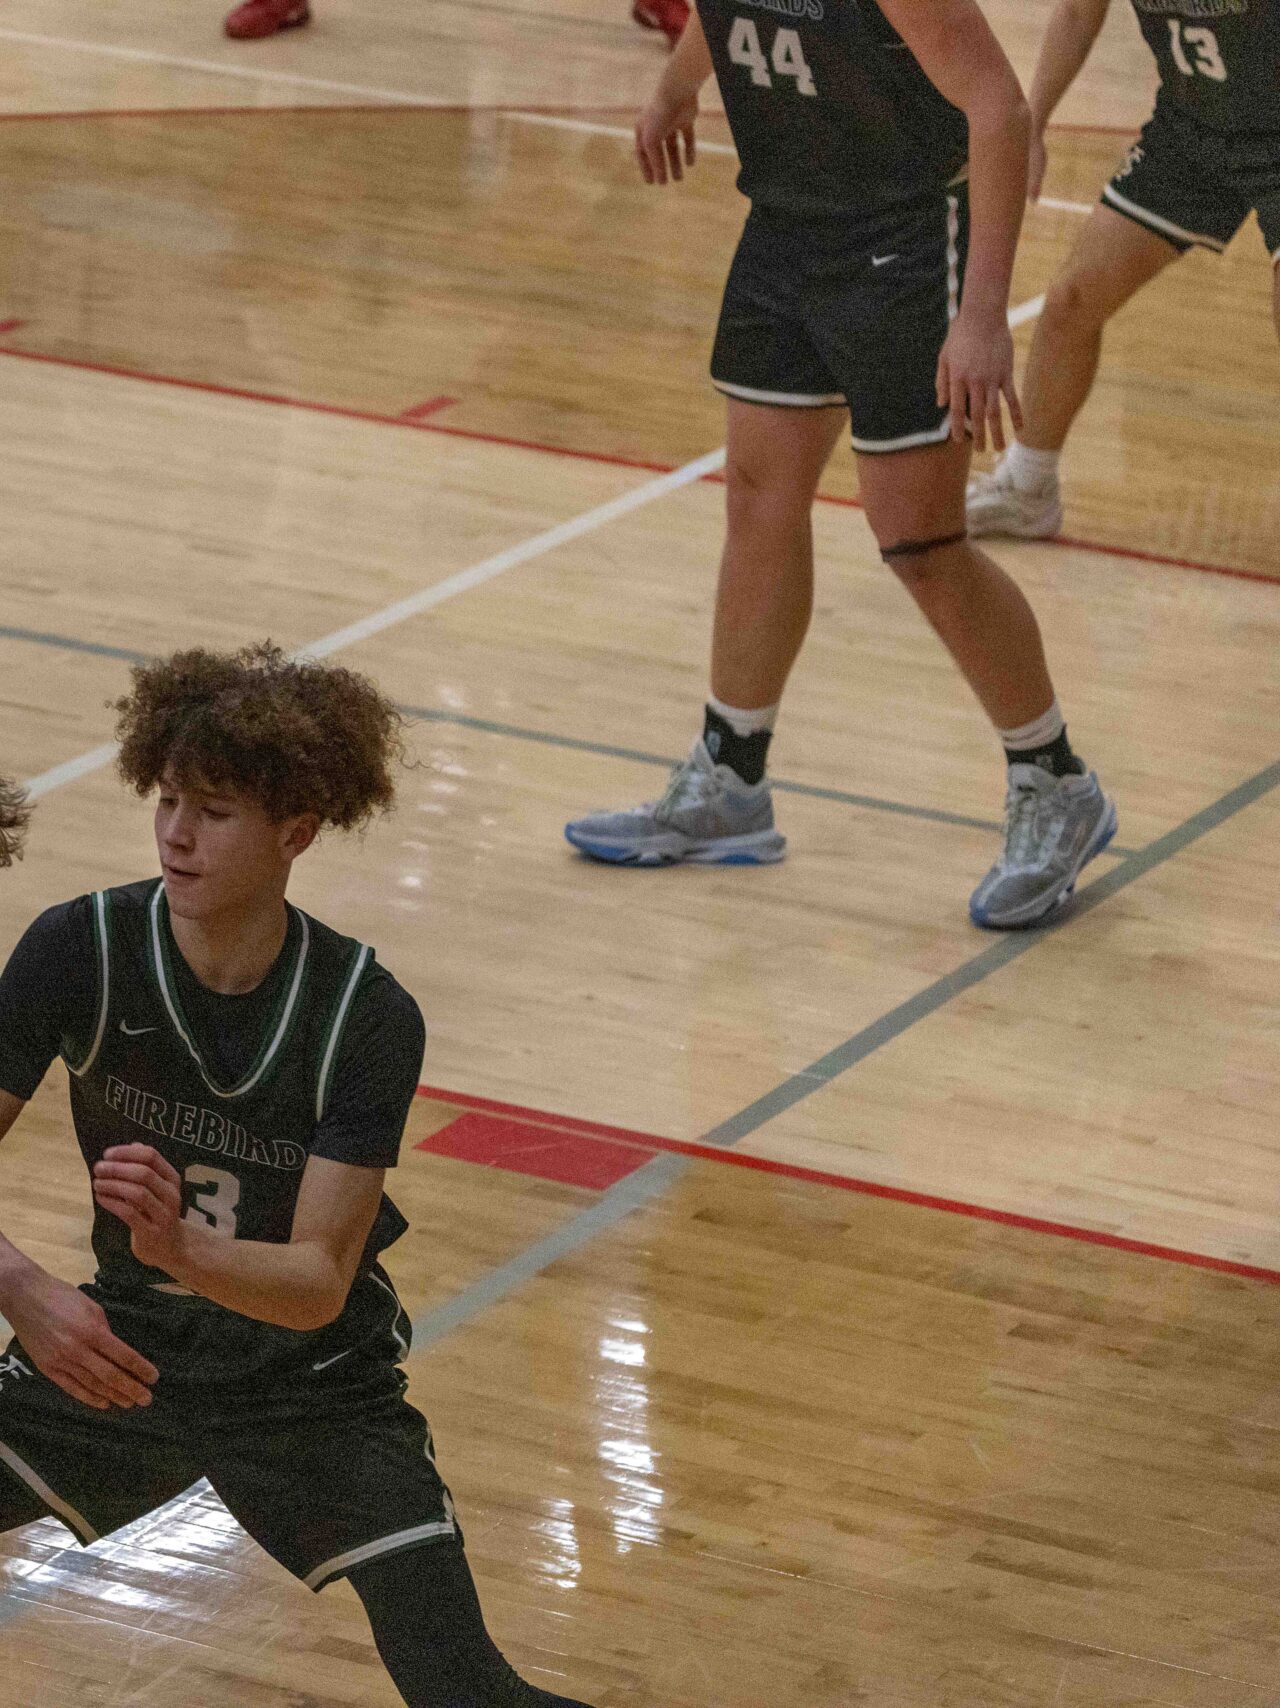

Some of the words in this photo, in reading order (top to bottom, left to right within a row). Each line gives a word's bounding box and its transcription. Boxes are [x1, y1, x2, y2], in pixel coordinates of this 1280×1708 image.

[727, 16, 818, 96] 44
[1167, 19, 1227, 82] 13
[179, 1164, 240, 1240] 3
